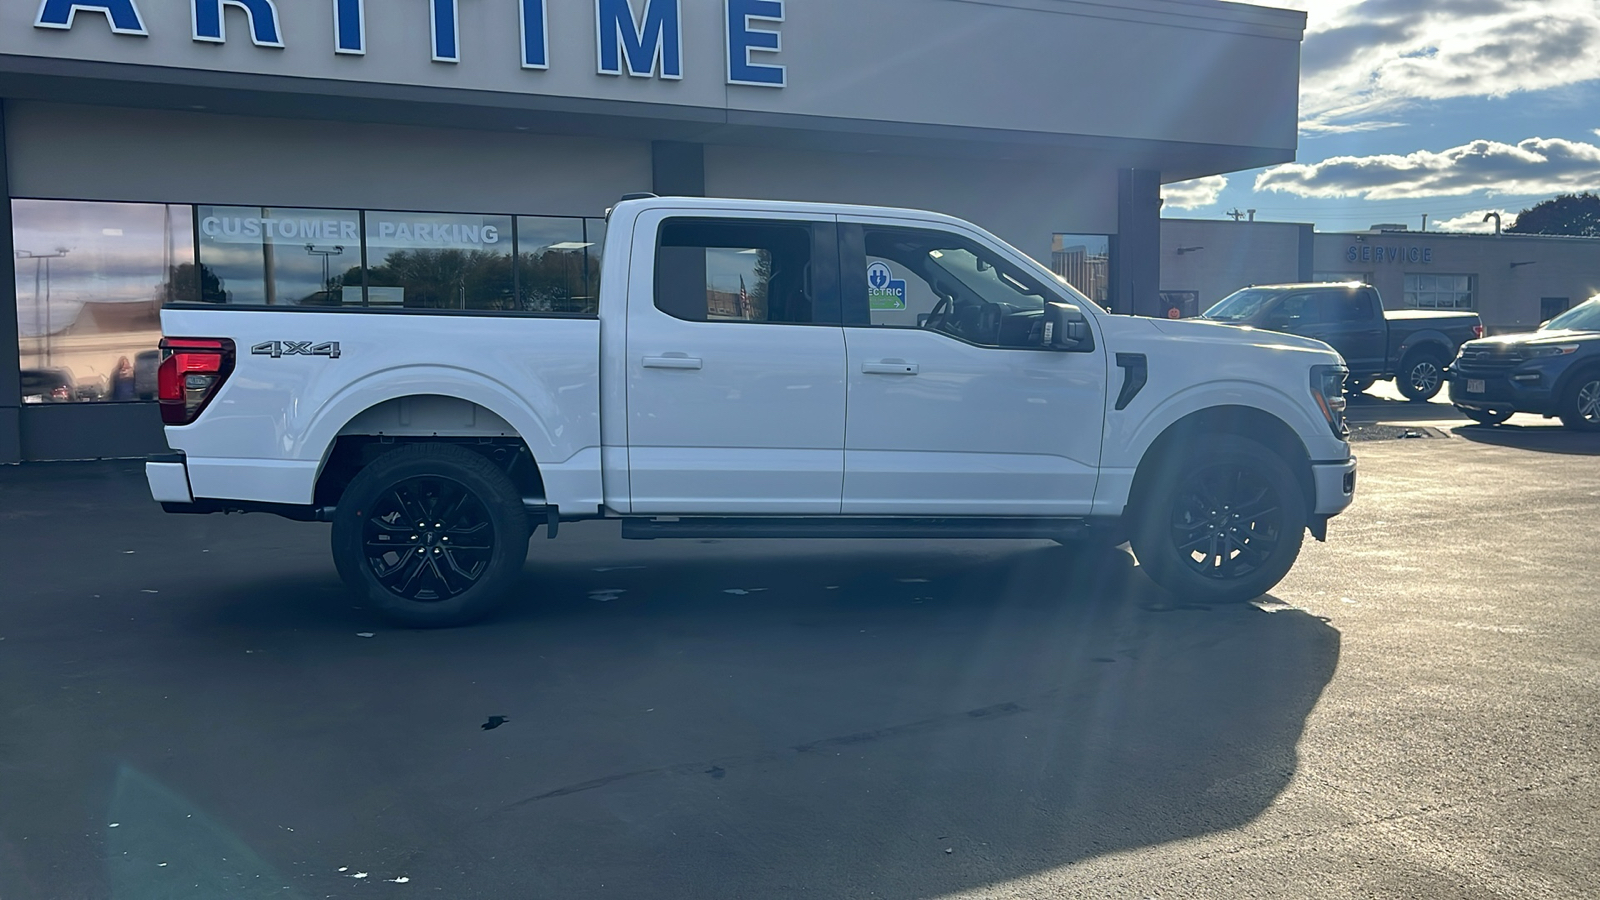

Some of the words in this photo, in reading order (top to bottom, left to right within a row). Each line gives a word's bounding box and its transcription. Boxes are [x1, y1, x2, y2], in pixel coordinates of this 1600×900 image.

[202, 216, 358, 240] CUSTOMER
[378, 221, 499, 244] PARKING
[1347, 245, 1432, 262] SERVICE
